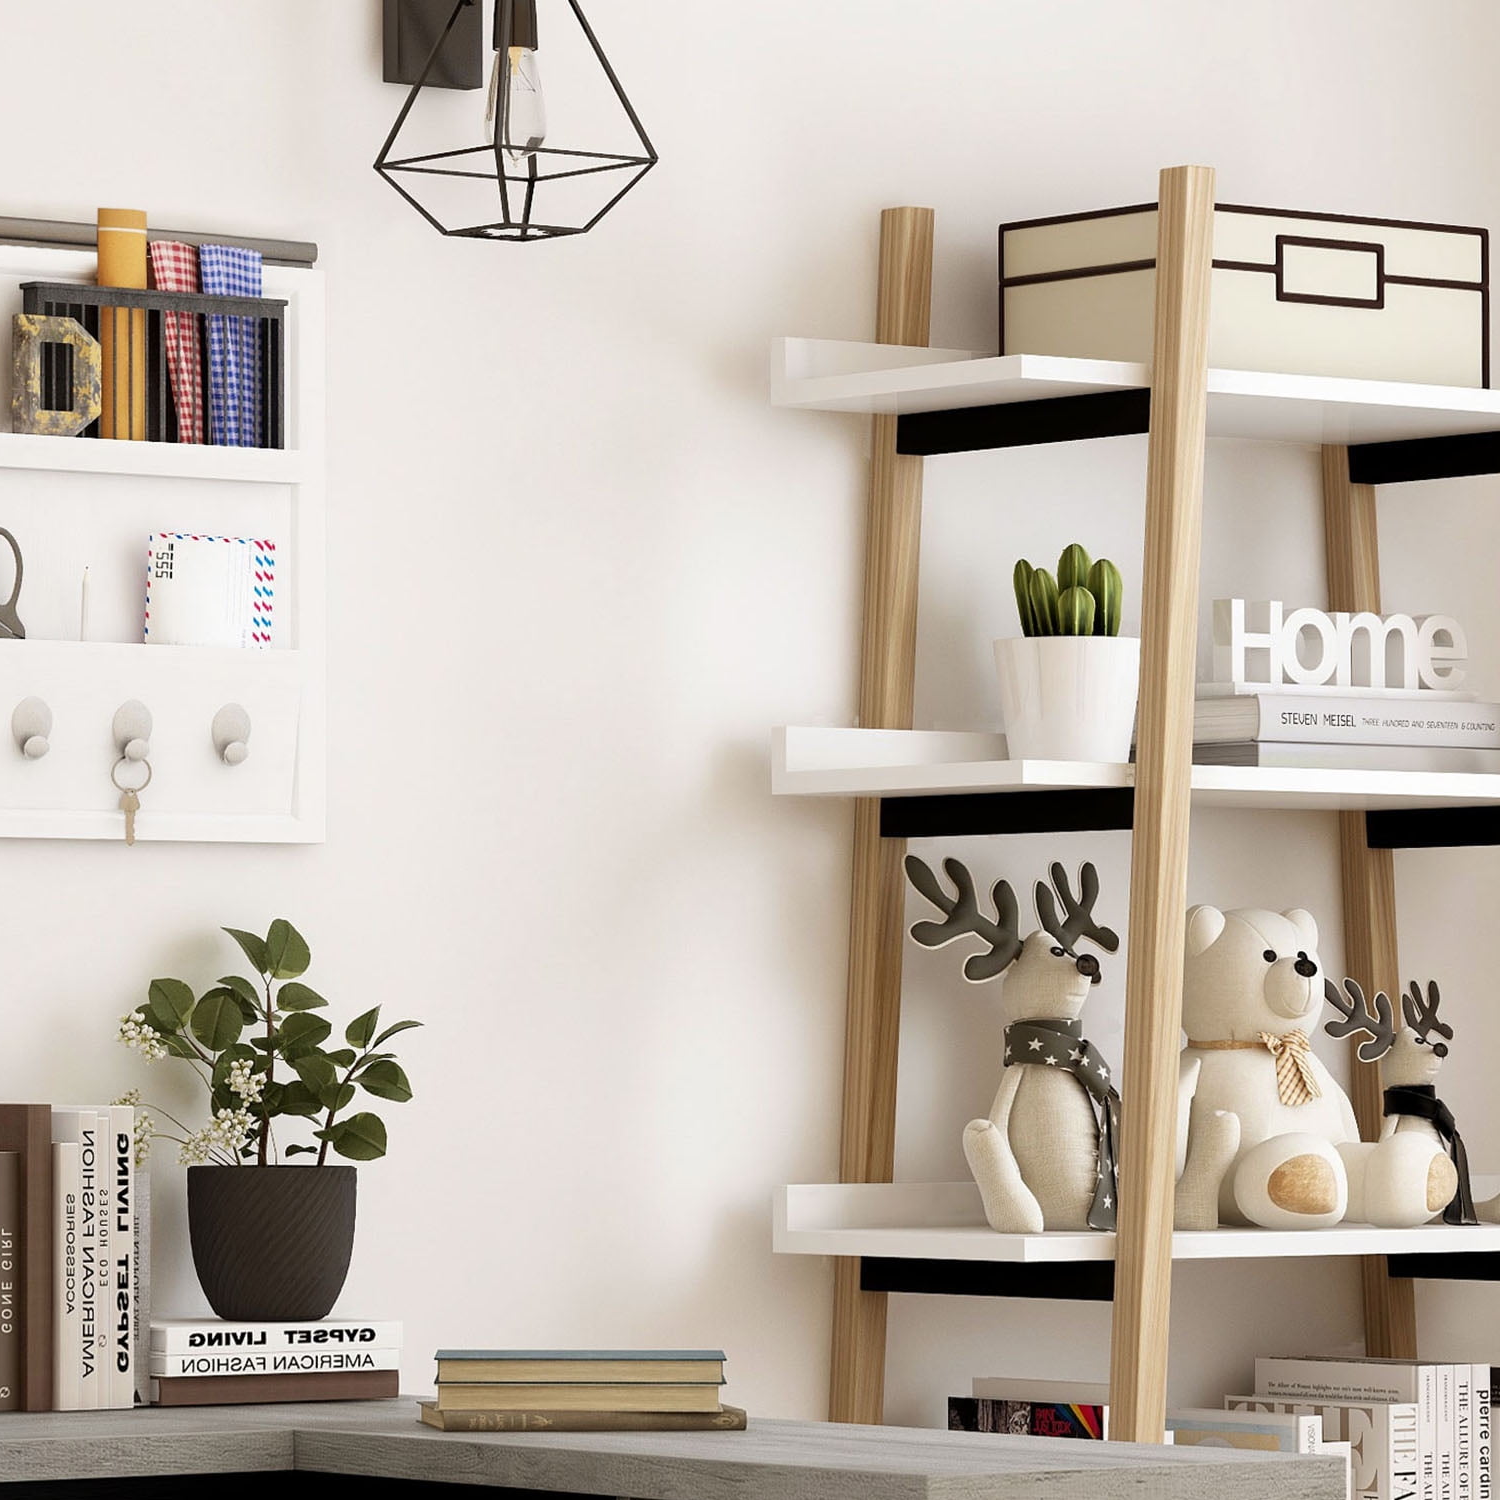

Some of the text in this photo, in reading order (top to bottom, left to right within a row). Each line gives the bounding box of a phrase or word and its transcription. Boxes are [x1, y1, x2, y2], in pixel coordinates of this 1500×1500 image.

[1227, 598, 1468, 692] Home
[1281, 712, 1318, 727] STEVEN
[1322, 713, 1356, 728] MEISEL
[1459, 1381, 1468, 1411] THE
[1476, 1389, 1490, 1440] pierre
[1393, 1407, 1416, 1463] THE
[1459, 1414, 1469, 1470] ALLURE
[1423, 1452, 1433, 1478] THE
[1441, 1451, 1450, 1478] THE
[1460, 1472, 1469, 1492] OF
[1479, 1445, 1492, 1499] cardin
